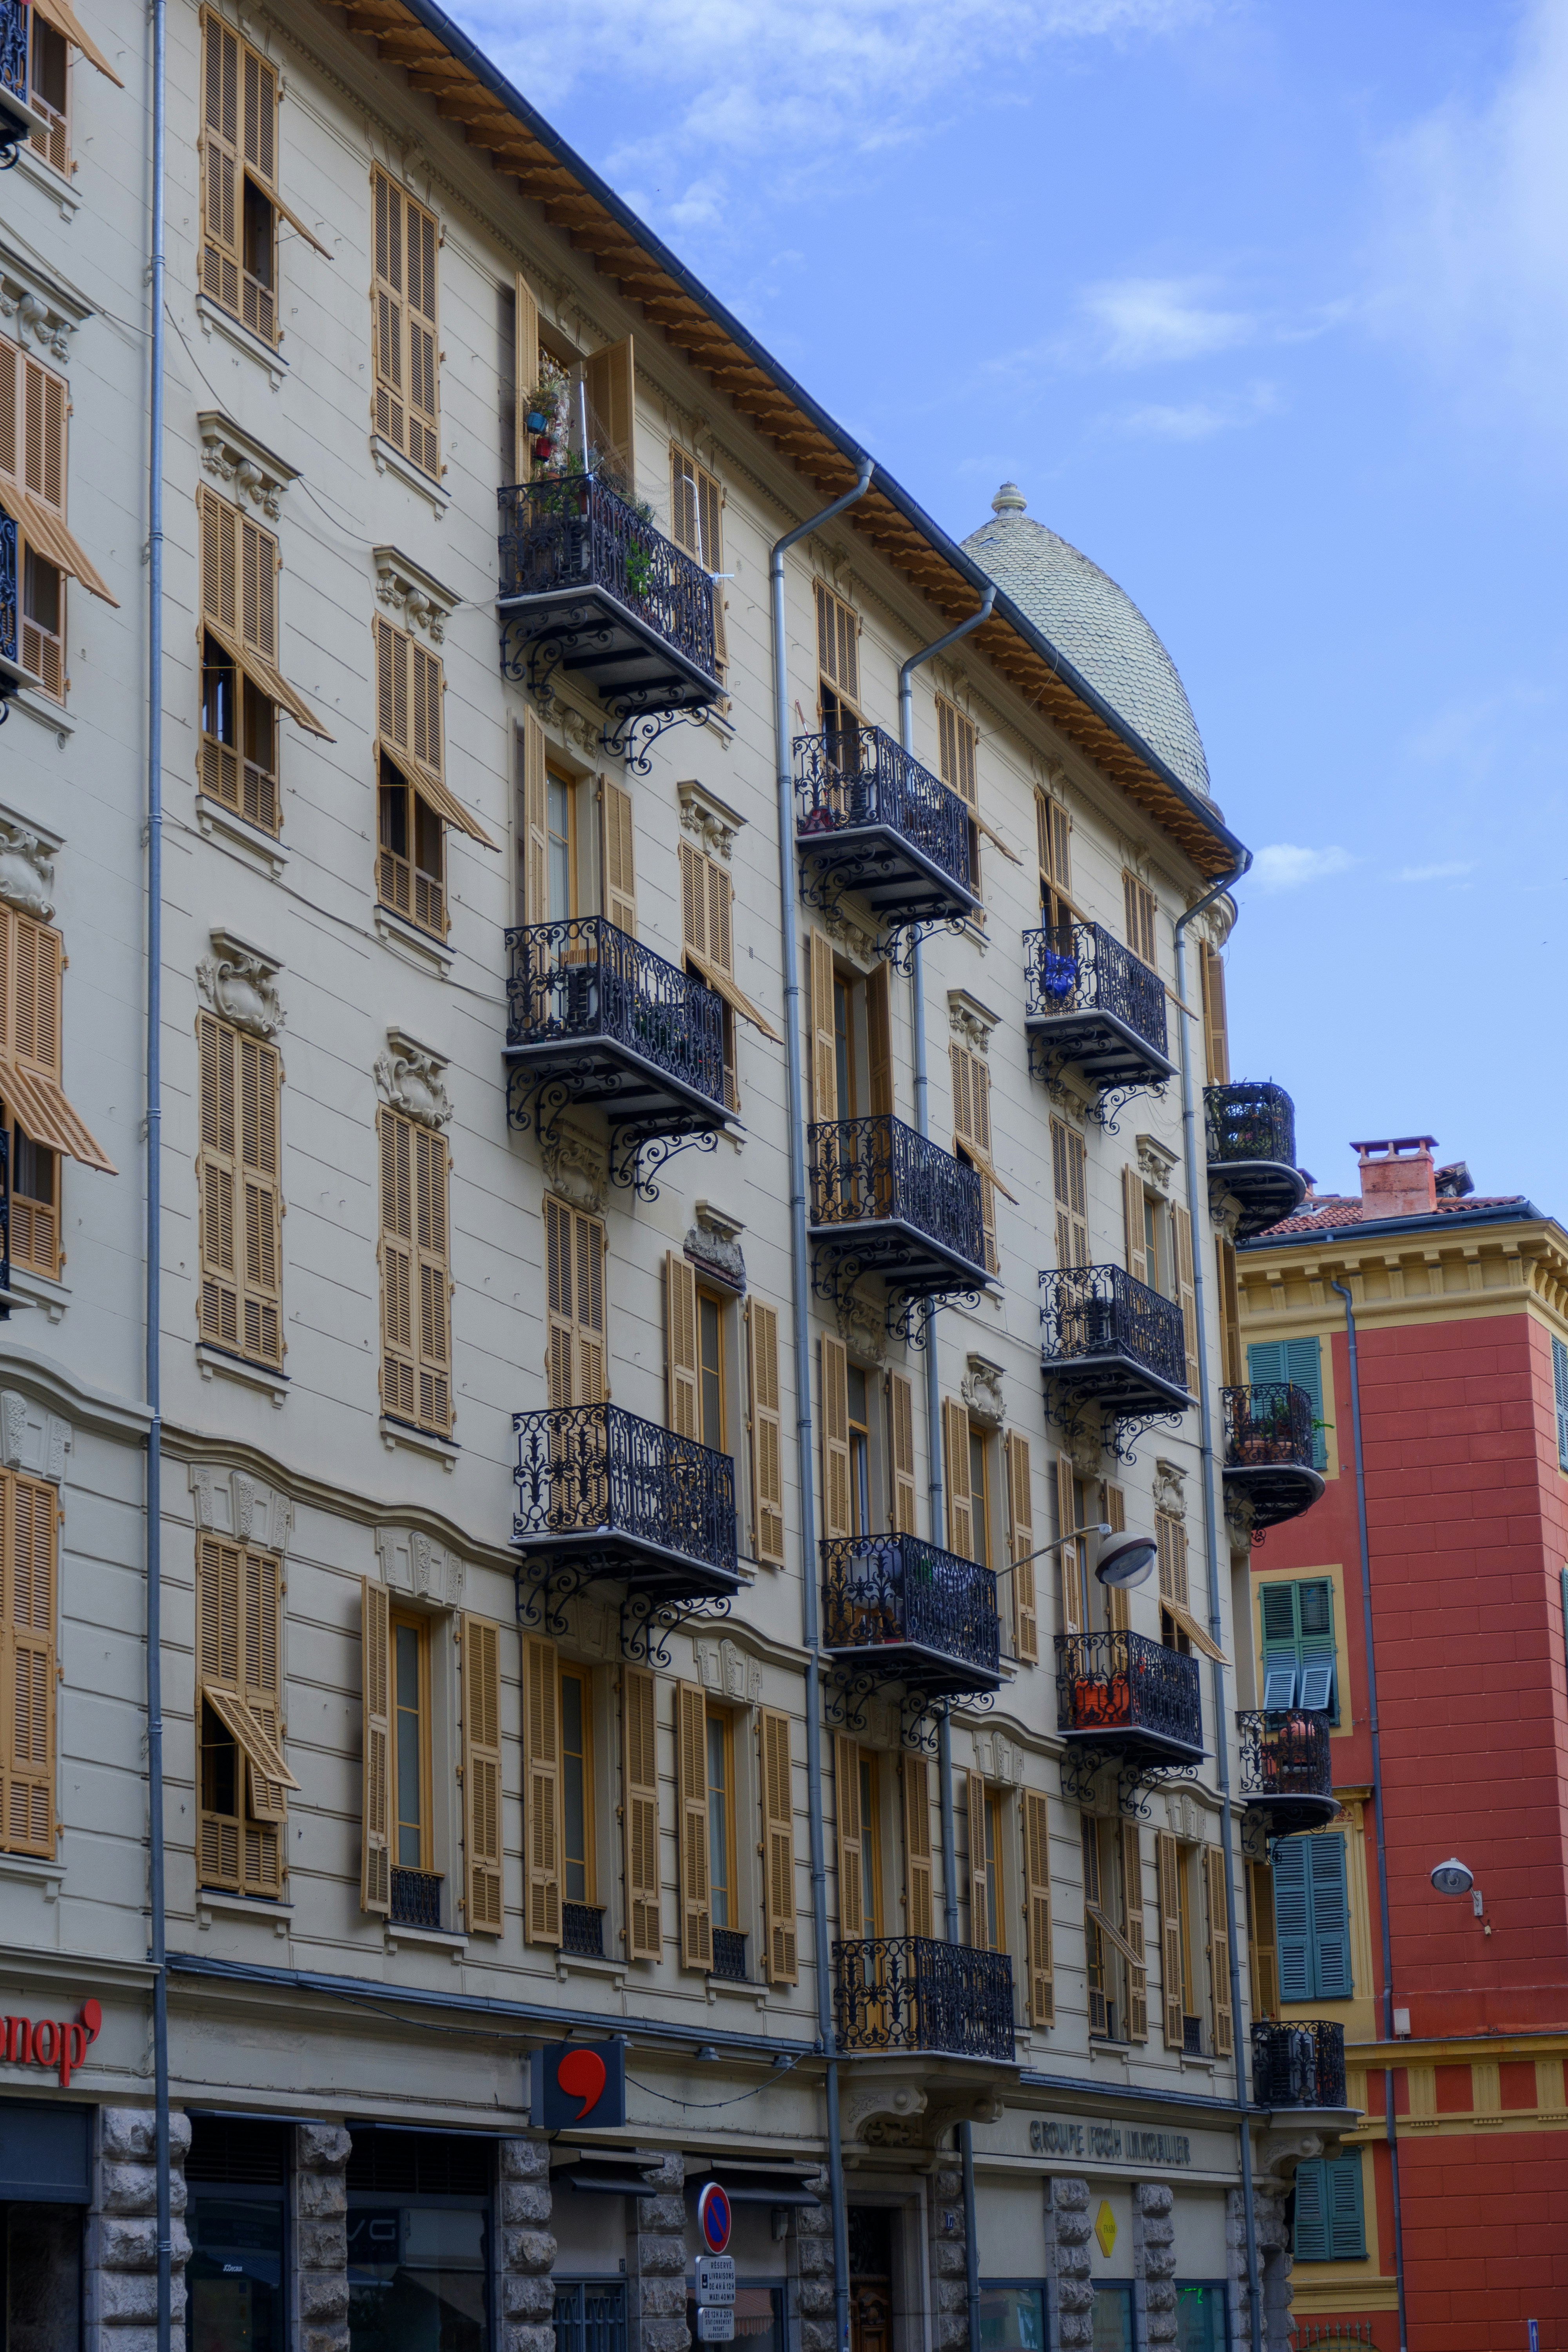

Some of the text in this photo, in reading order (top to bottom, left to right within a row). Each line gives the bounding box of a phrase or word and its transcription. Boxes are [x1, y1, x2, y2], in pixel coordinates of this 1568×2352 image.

[0, 1998, 102, 2087] nop'
[1030, 2120, 1191, 2162] GROUPE FOCH IMMOBILIER
[947, 2215, 953, 2227] 17
[1103, 2225, 1115, 2234] FNAIM
[223, 2264, 243, 2272] JCDecaux
[620, 2261, 625, 2270] 17
[711, 2261, 732, 2269] RÉSERVÉ
